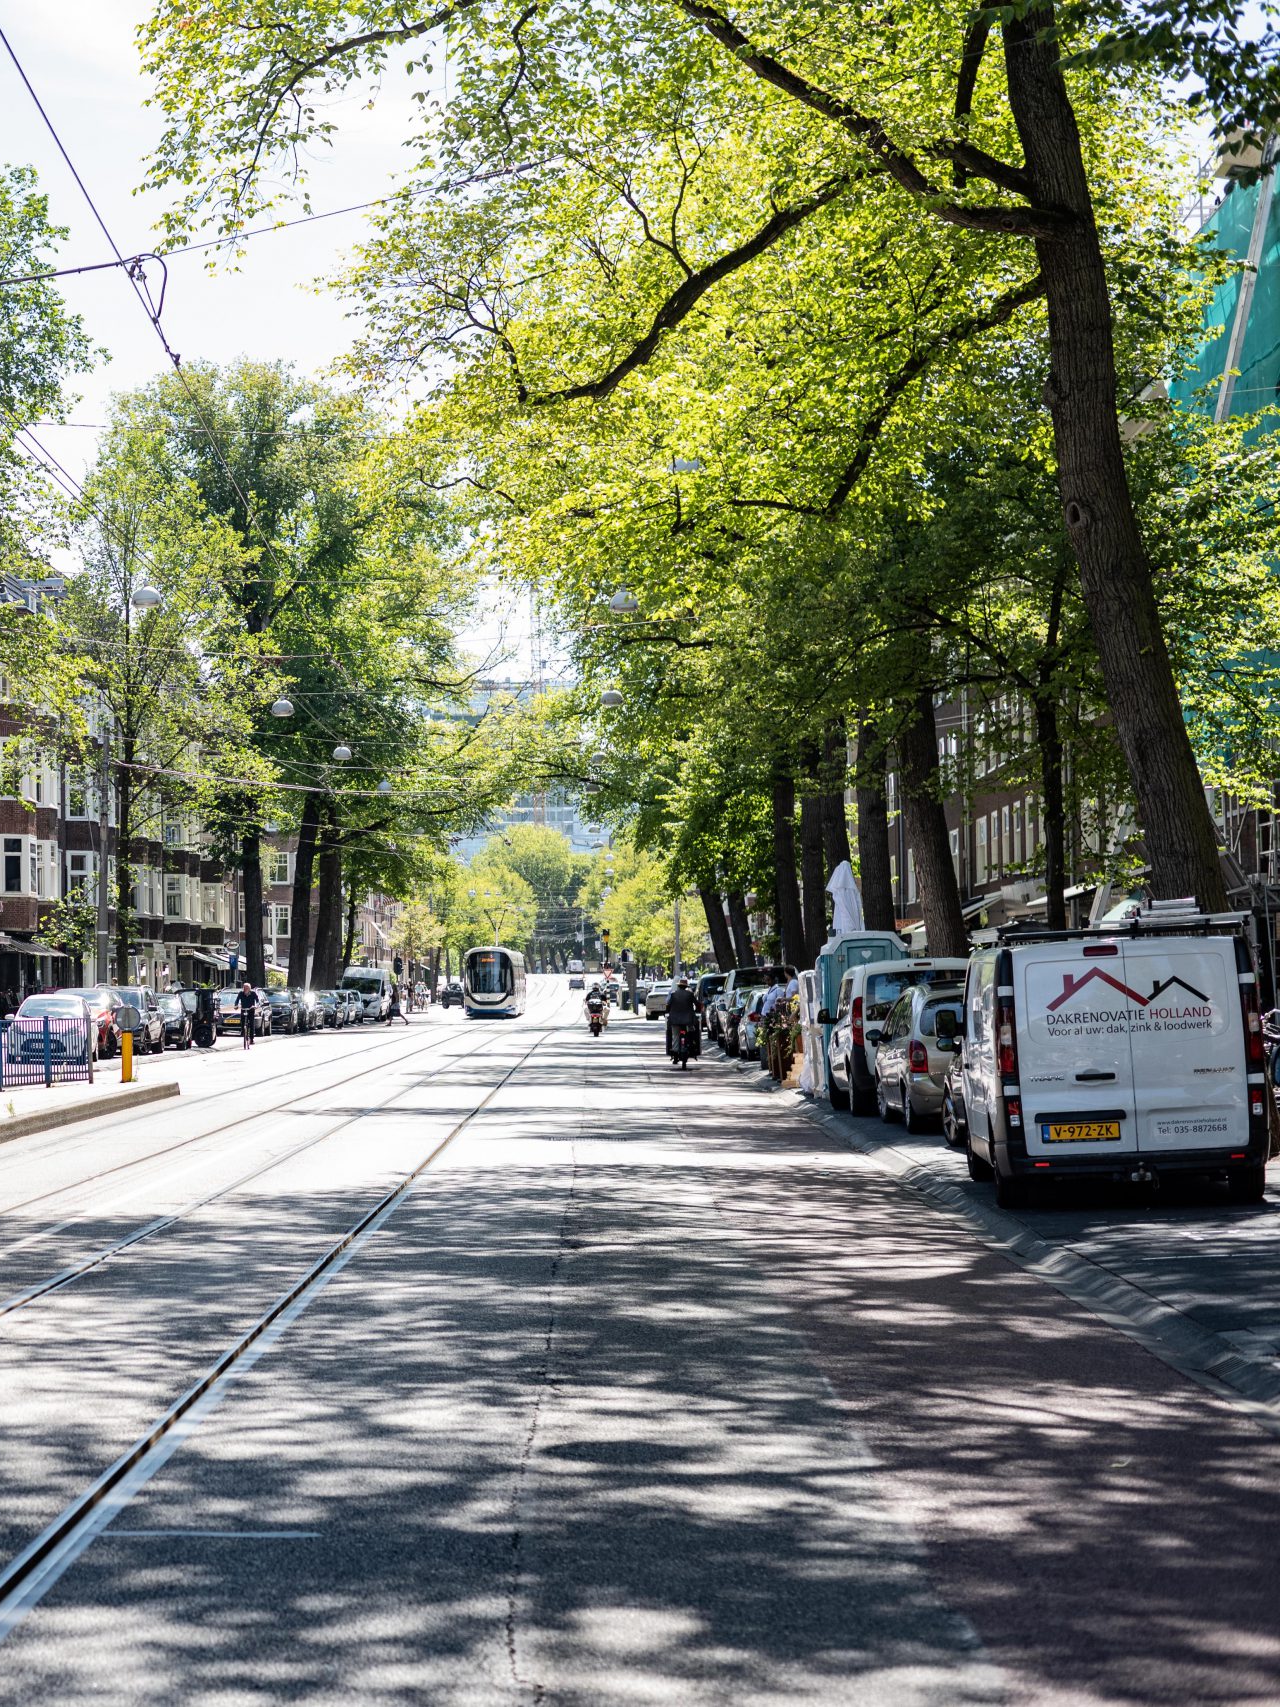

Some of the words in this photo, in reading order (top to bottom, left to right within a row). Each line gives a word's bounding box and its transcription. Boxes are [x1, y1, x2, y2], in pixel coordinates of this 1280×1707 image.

[1046, 1009, 1145, 1026] DAKRENOVATIE
[1149, 1005, 1212, 1020] HOLLAND
[1047, 1027, 1071, 1037] Voor
[1074, 1026, 1083, 1036] al
[1086, 1026, 1104, 1035] uw:
[1106, 1023, 1128, 1035] dak,
[1130, 1021, 1152, 1032] zink
[1154, 1022, 1162, 1031] &
[1164, 1018, 1213, 1031] loodwerk
[1054, 1124, 1113, 1137] V-972-ZK
[1174, 1124, 1228, 1133] 035-8872668
